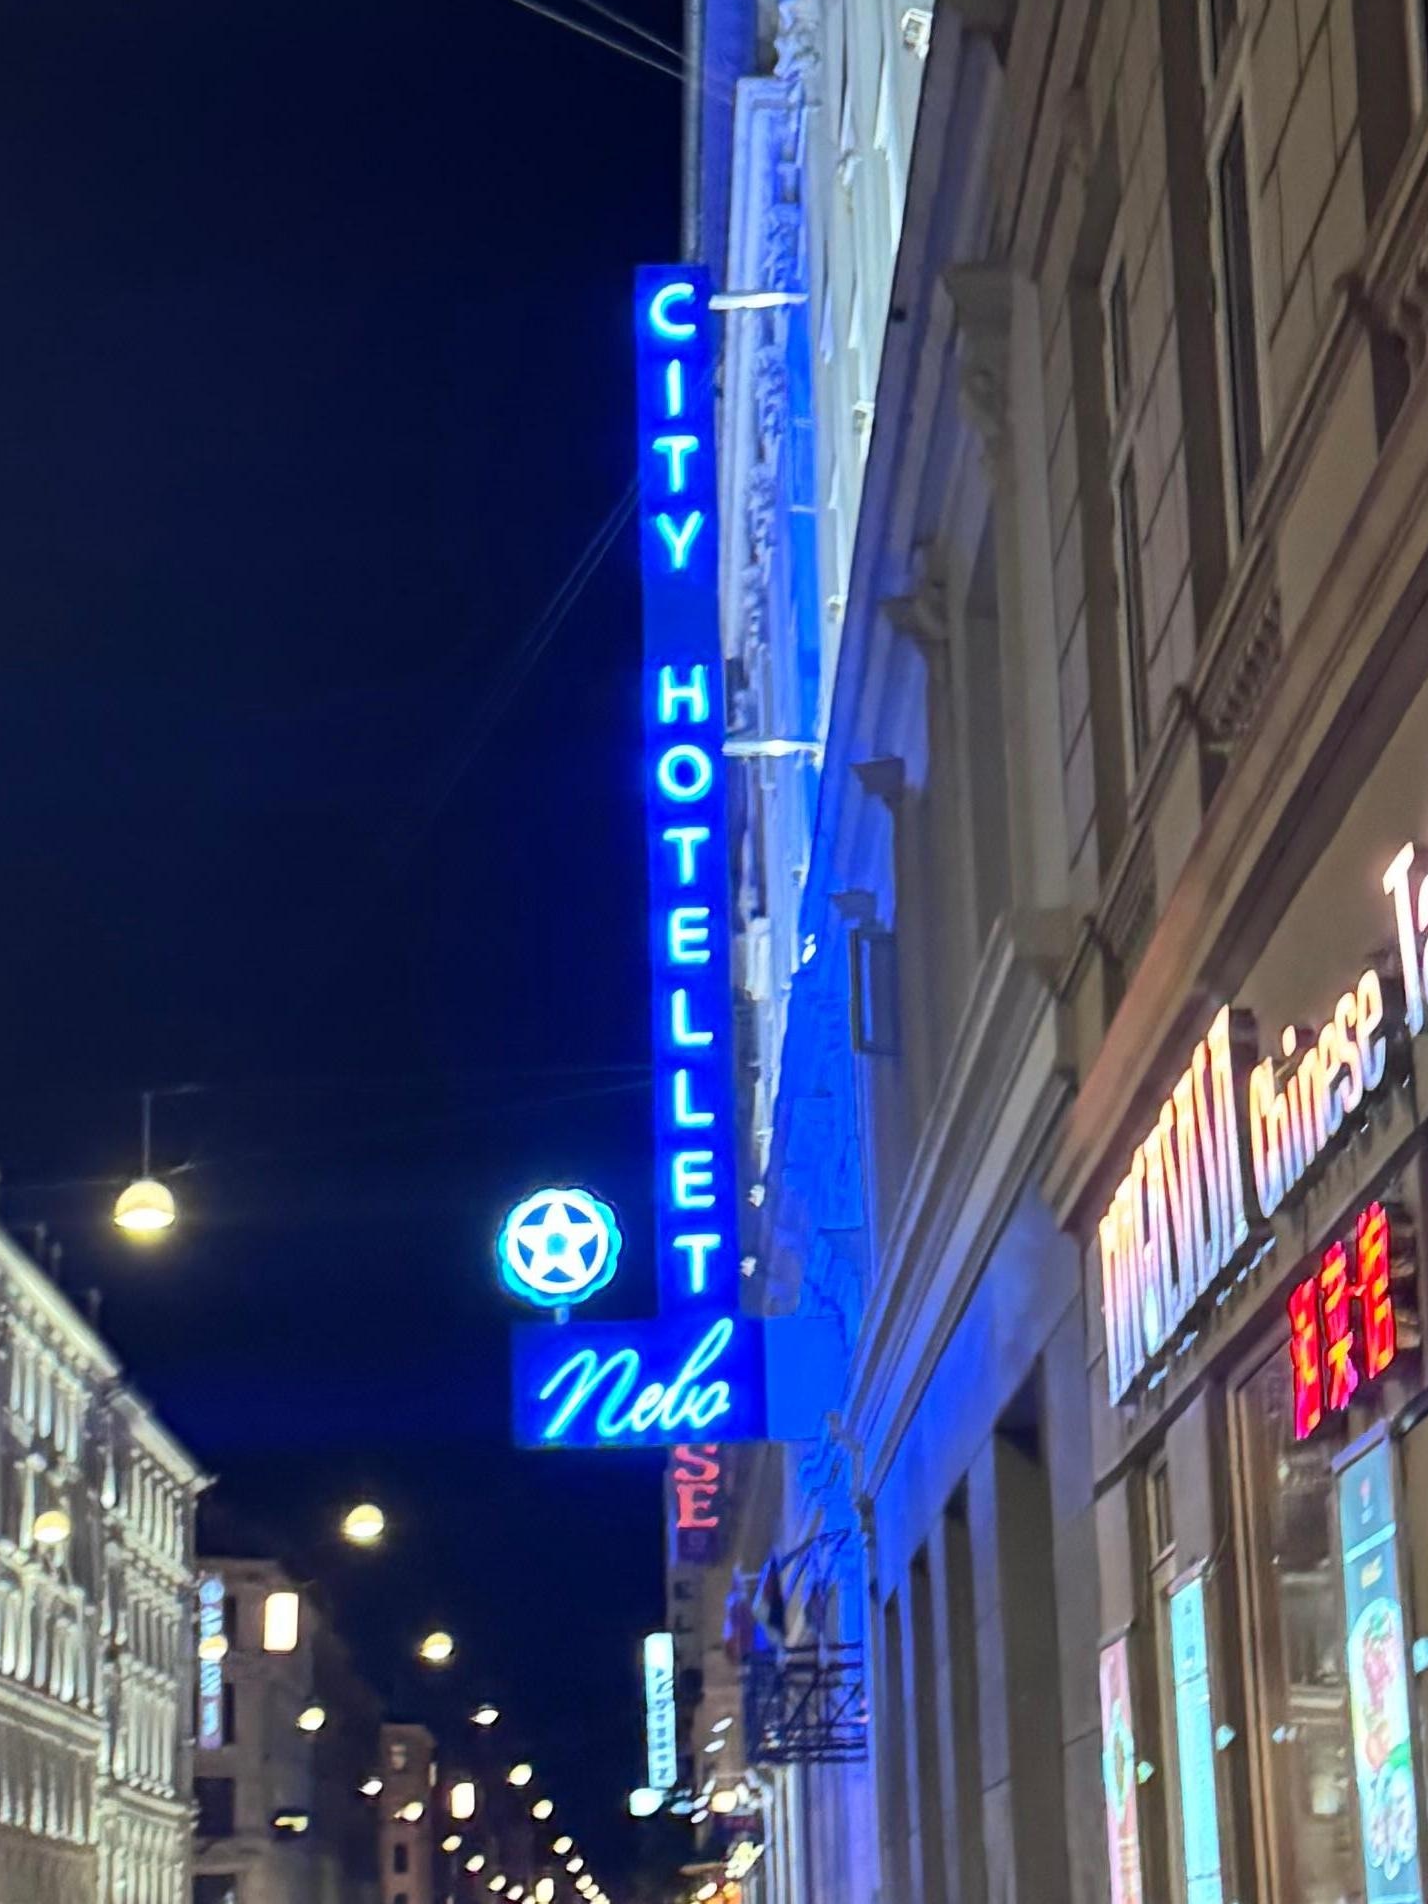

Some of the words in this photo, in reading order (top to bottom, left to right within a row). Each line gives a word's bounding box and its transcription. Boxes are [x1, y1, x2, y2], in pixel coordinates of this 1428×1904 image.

[650, 282, 704, 569] CITY
[657, 663, 722, 1294] HOTELLET
[539, 1317, 733, 1439] Nebo
